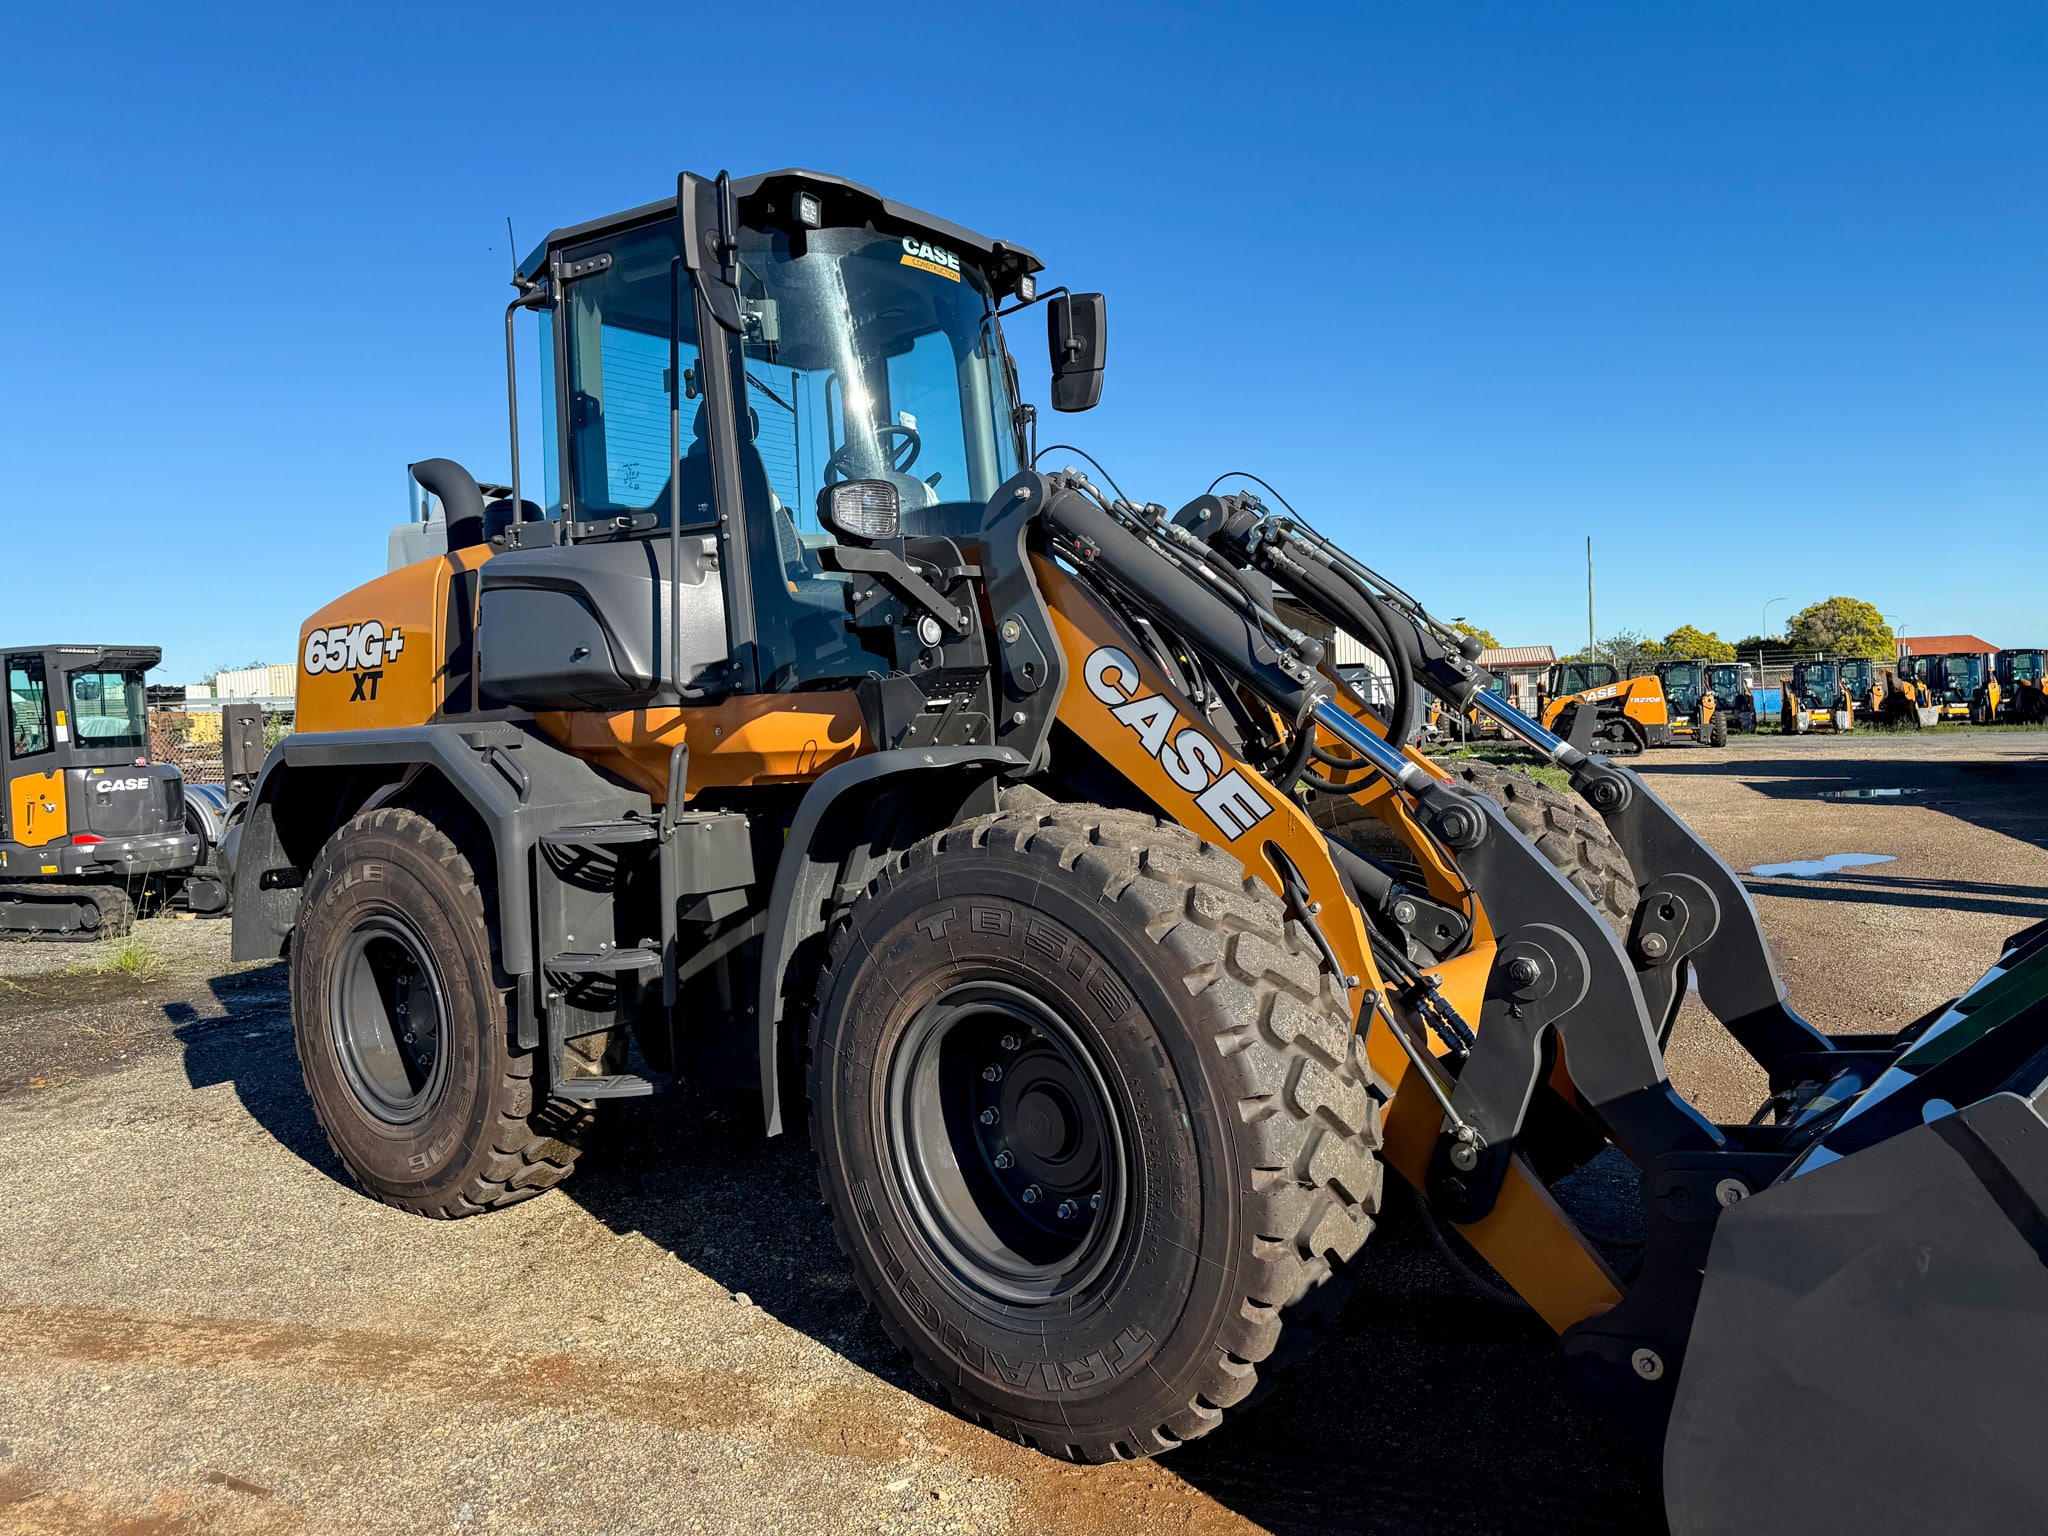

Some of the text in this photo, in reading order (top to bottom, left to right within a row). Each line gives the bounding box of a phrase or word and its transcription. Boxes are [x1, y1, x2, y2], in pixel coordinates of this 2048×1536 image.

[902, 236, 960, 271] CASE
[912, 258, 960, 280] CONSTRUCTION
[304, 619, 405, 676] 651G+
[349, 670, 383, 702] XT
[1083, 645, 1276, 843] CASE
[96, 778, 149, 793] CASE
[851, 1179, 1157, 1392] TRIANGLE
